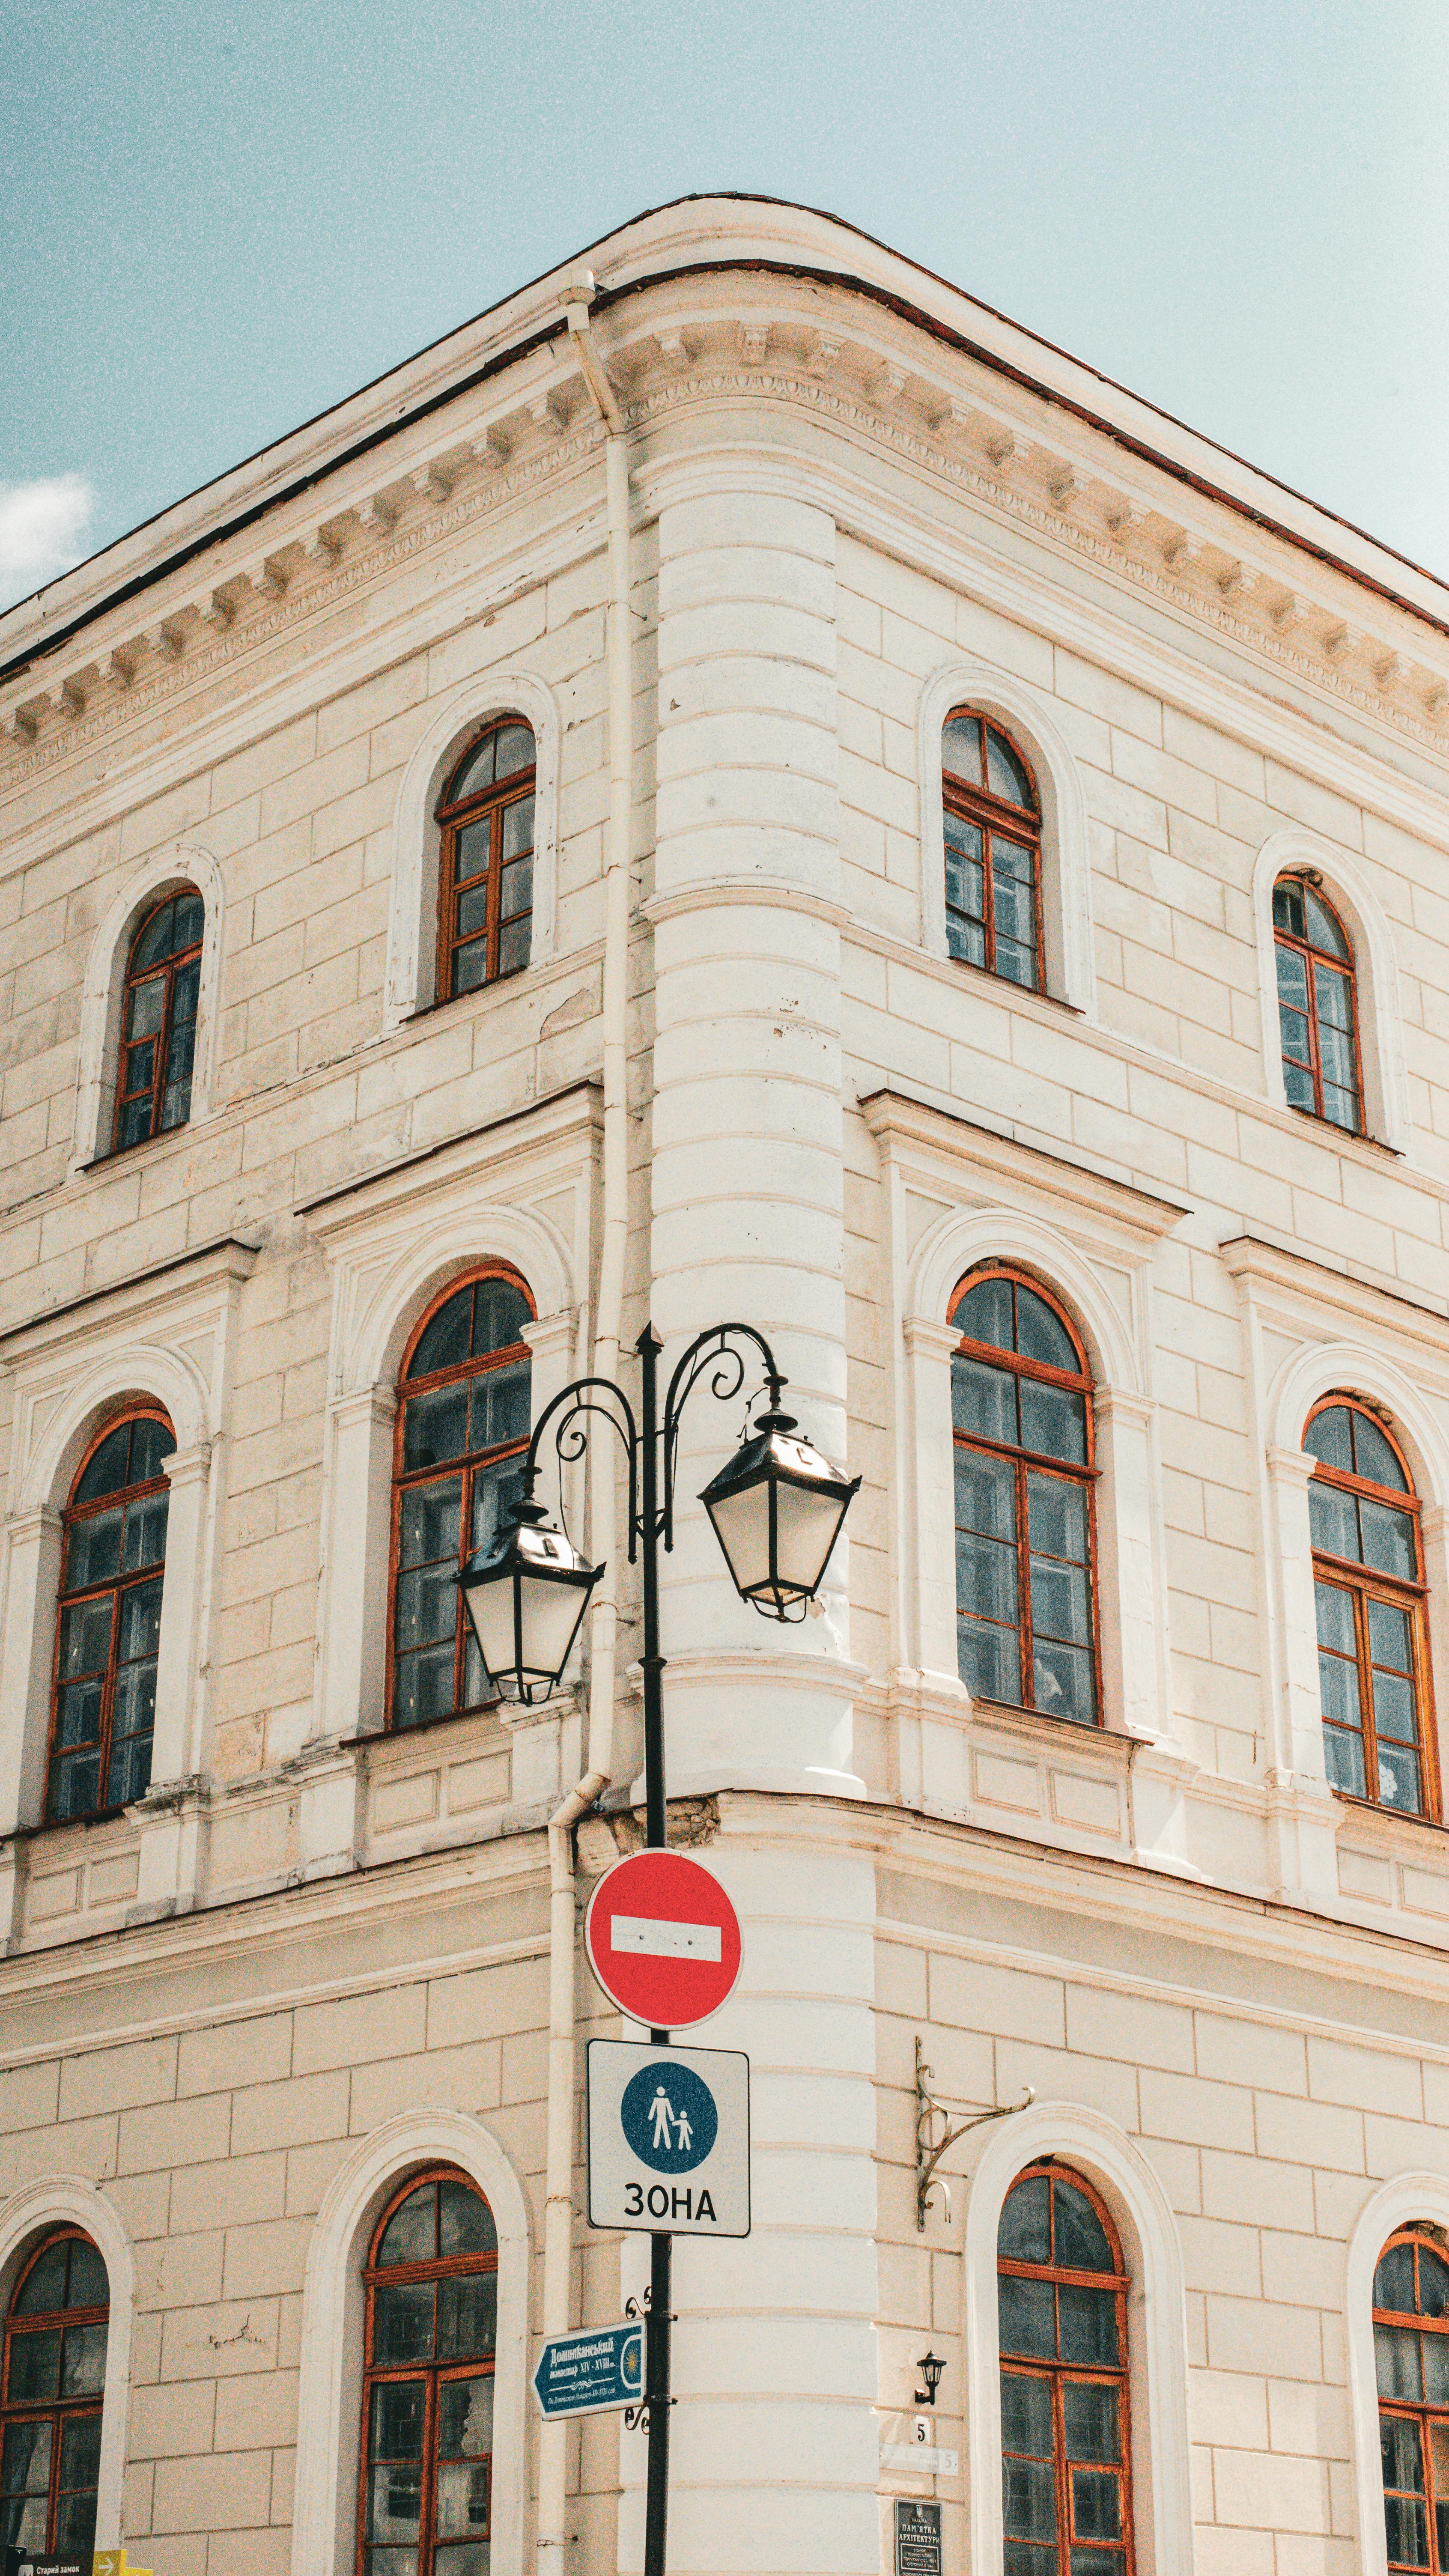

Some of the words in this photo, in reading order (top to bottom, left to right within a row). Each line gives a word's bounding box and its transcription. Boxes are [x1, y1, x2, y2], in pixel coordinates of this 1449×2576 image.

[624, 2183, 716, 2221] ЗОНА
[551, 2337, 614, 2368] Домініканський
[580, 2361, 590, 2373] XIV
[918, 2424, 925, 2442] 5
[945, 2454, 952, 2469] 5
[899, 2534, 940, 2544] АРХІТЕКТУРИ
[37, 2565, 59, 2576] Старий
